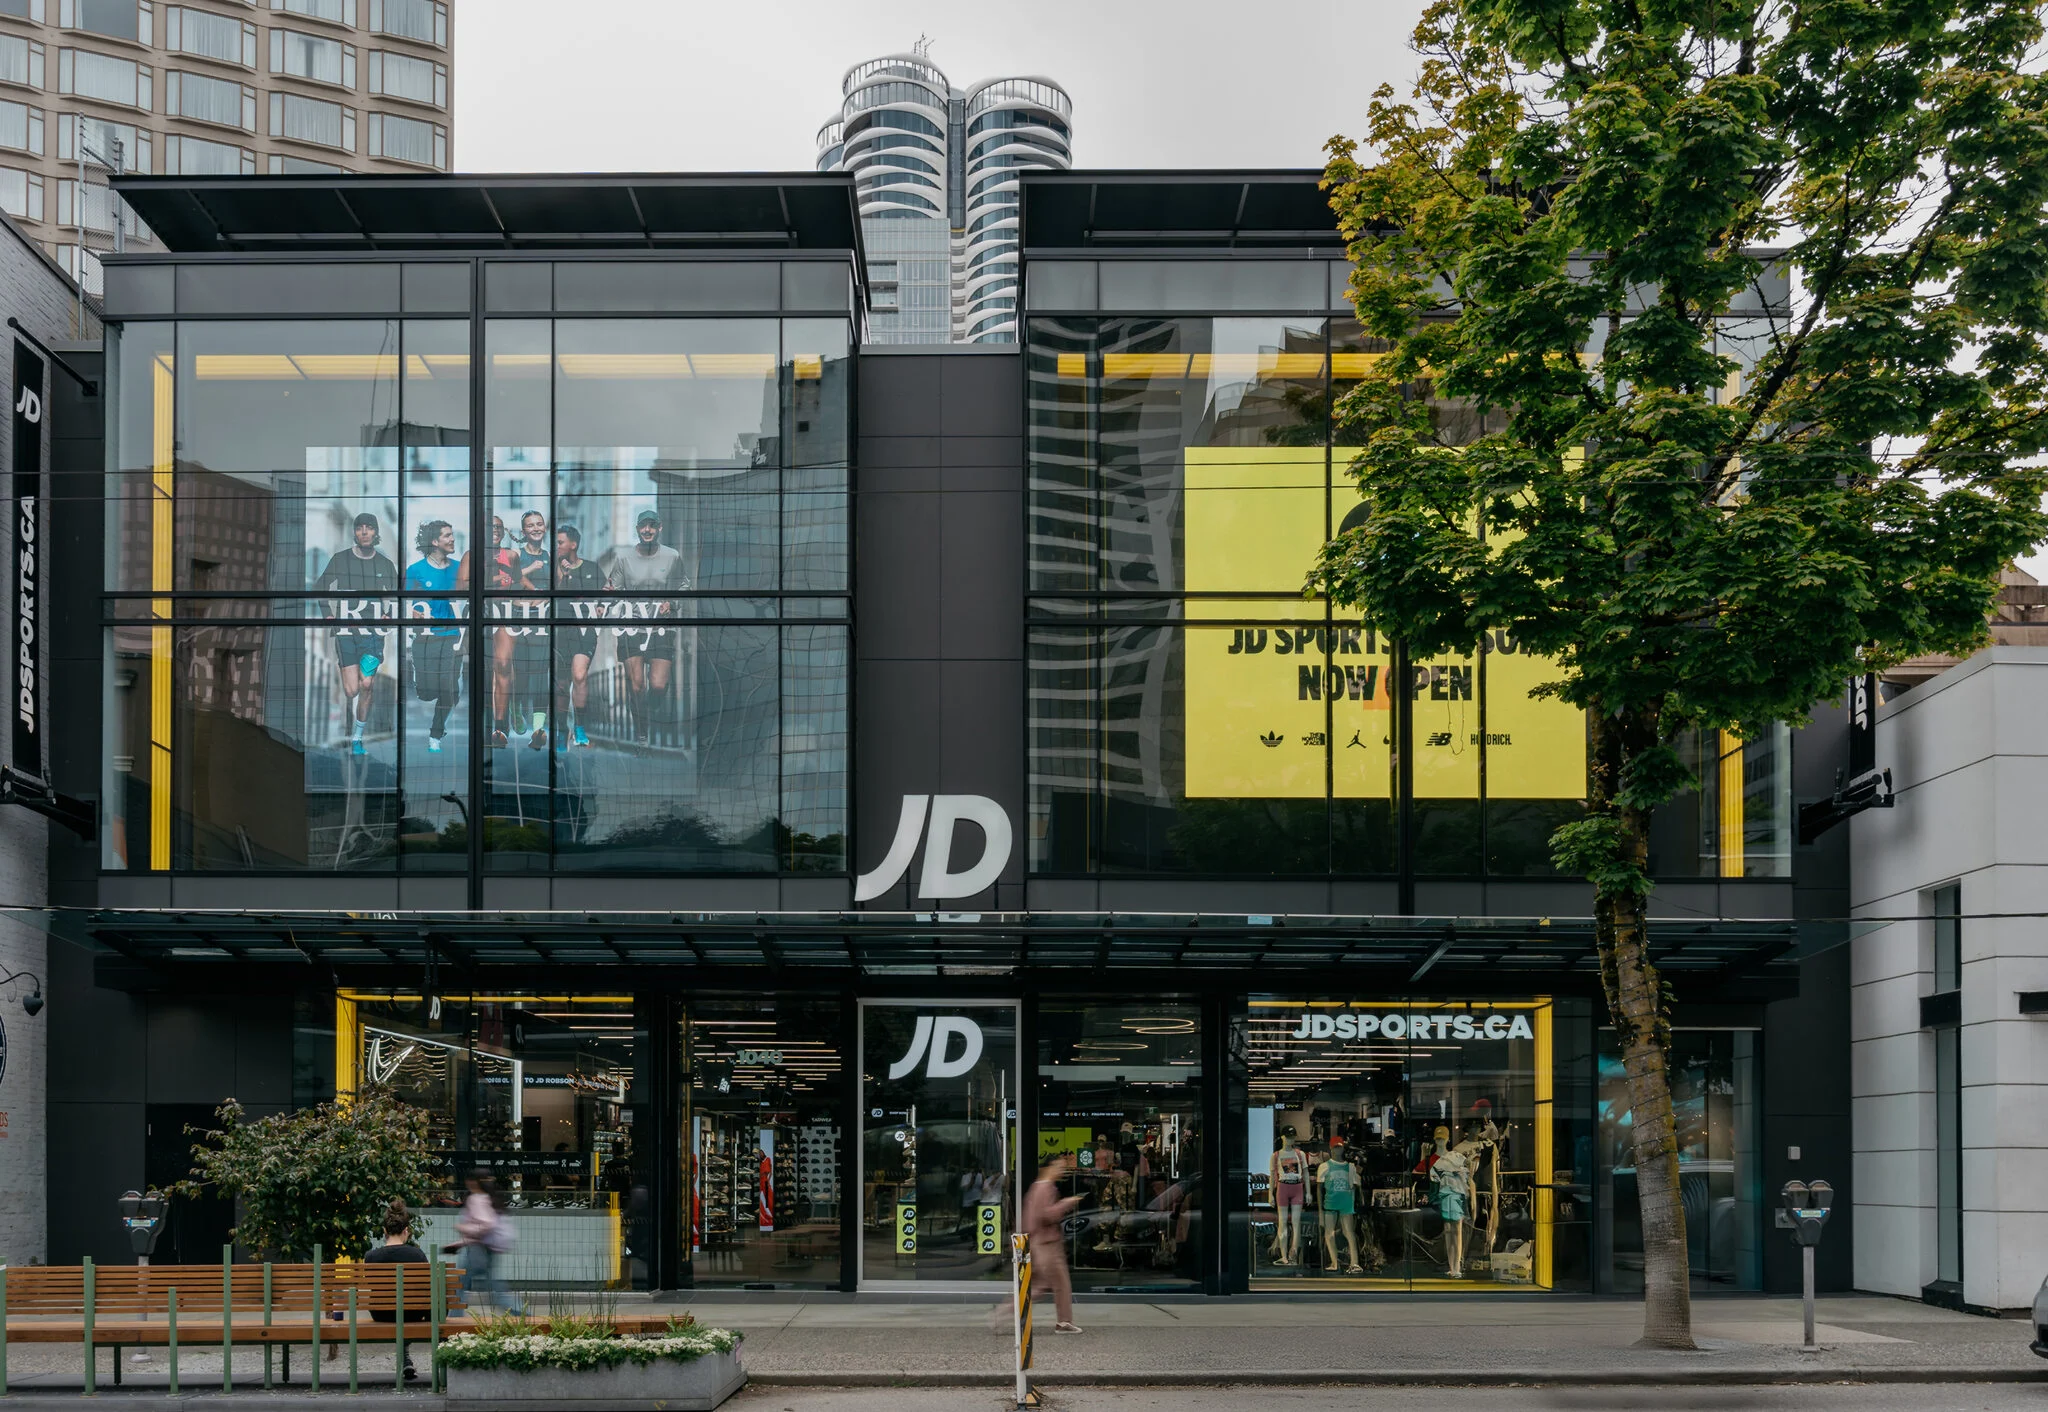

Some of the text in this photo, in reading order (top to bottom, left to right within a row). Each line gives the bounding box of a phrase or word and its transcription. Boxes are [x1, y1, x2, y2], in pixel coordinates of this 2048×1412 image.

[16, 384, 41, 424] JD
[19, 495, 36, 735] JDSPORTS.CA
[570, 600, 666, 652] way.
[1228, 619, 1267, 655] JD
[1298, 665, 1378, 701] NOW
[854, 794, 1013, 902] JD
[1292, 1013, 1534, 1040] JDSPORTS.CA
[736, 1050, 784, 1066] 1040
[888, 1015, 984, 1080] JD
[904, 1210, 915, 1218] JD
[983, 1210, 994, 1218] JD
[904, 1225, 915, 1233] JD
[983, 1225, 994, 1233] JD
[904, 1241, 915, 1249] JD
[983, 1241, 994, 1249] JD
